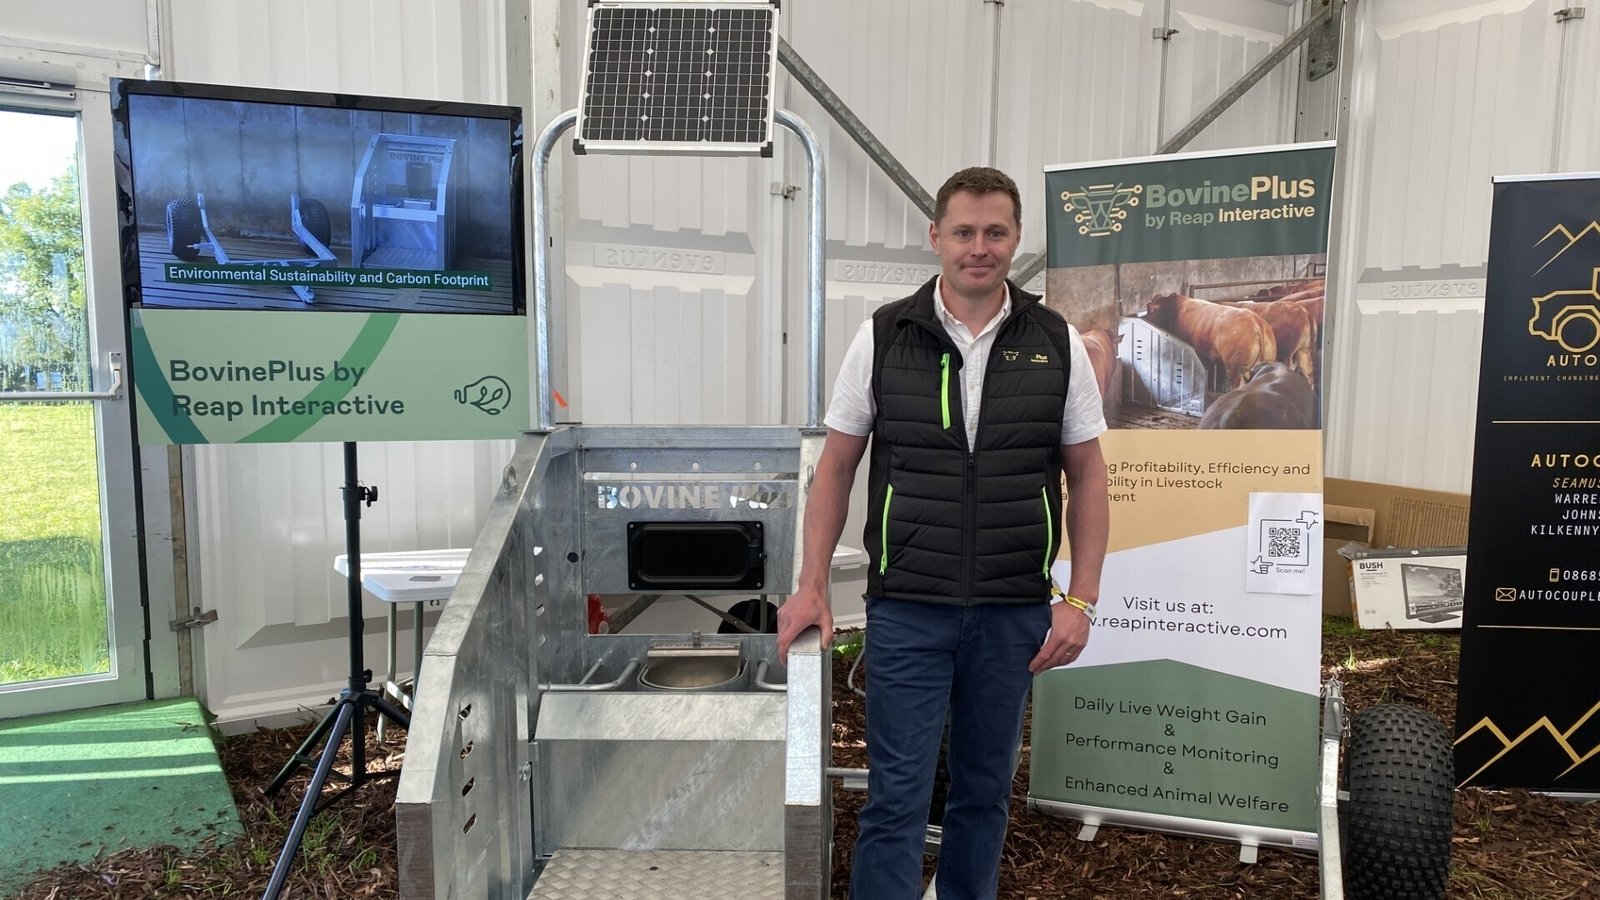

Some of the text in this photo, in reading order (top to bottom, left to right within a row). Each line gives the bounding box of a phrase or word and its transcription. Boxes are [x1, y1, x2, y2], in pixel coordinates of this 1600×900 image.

[1146, 175, 1316, 208] BovinePlus
[1145, 204, 1315, 228] by Reap Interactive
[169, 266, 489, 288] Environmental Sustainability and Carbon Footprint
[1546, 354, 1598, 367] AUTO
[170, 359, 366, 387] BovinePlus by
[172, 394, 405, 421] Reap Interactive
[1121, 461, 1205, 475] Profitability,
[1208, 462, 1280, 477] Efficiency
[1283, 464, 1311, 475] and
[1141, 476, 1153, 488] in
[1156, 476, 1223, 489] Livestock
[597, 485, 721, 509] BOVINE
[1555, 493, 1600, 504] WARRE
[1562, 509, 1600, 520] JOHN
[1531, 524, 1600, 536] KILKENNY
[1359, 562, 1383, 570] BUSH
[1563, 570, 1600, 581] 0868
[1123, 597, 1214, 615] Visit us at:
[1074, 696, 1267, 726] Daily Live Weight Gain
[1164, 724, 1176, 737] &
[1066, 733, 1279, 769] Performance Monitoring
[1163, 762, 1175, 775] &
[1065, 776, 1290, 813] Enhanced Animal Welfare
